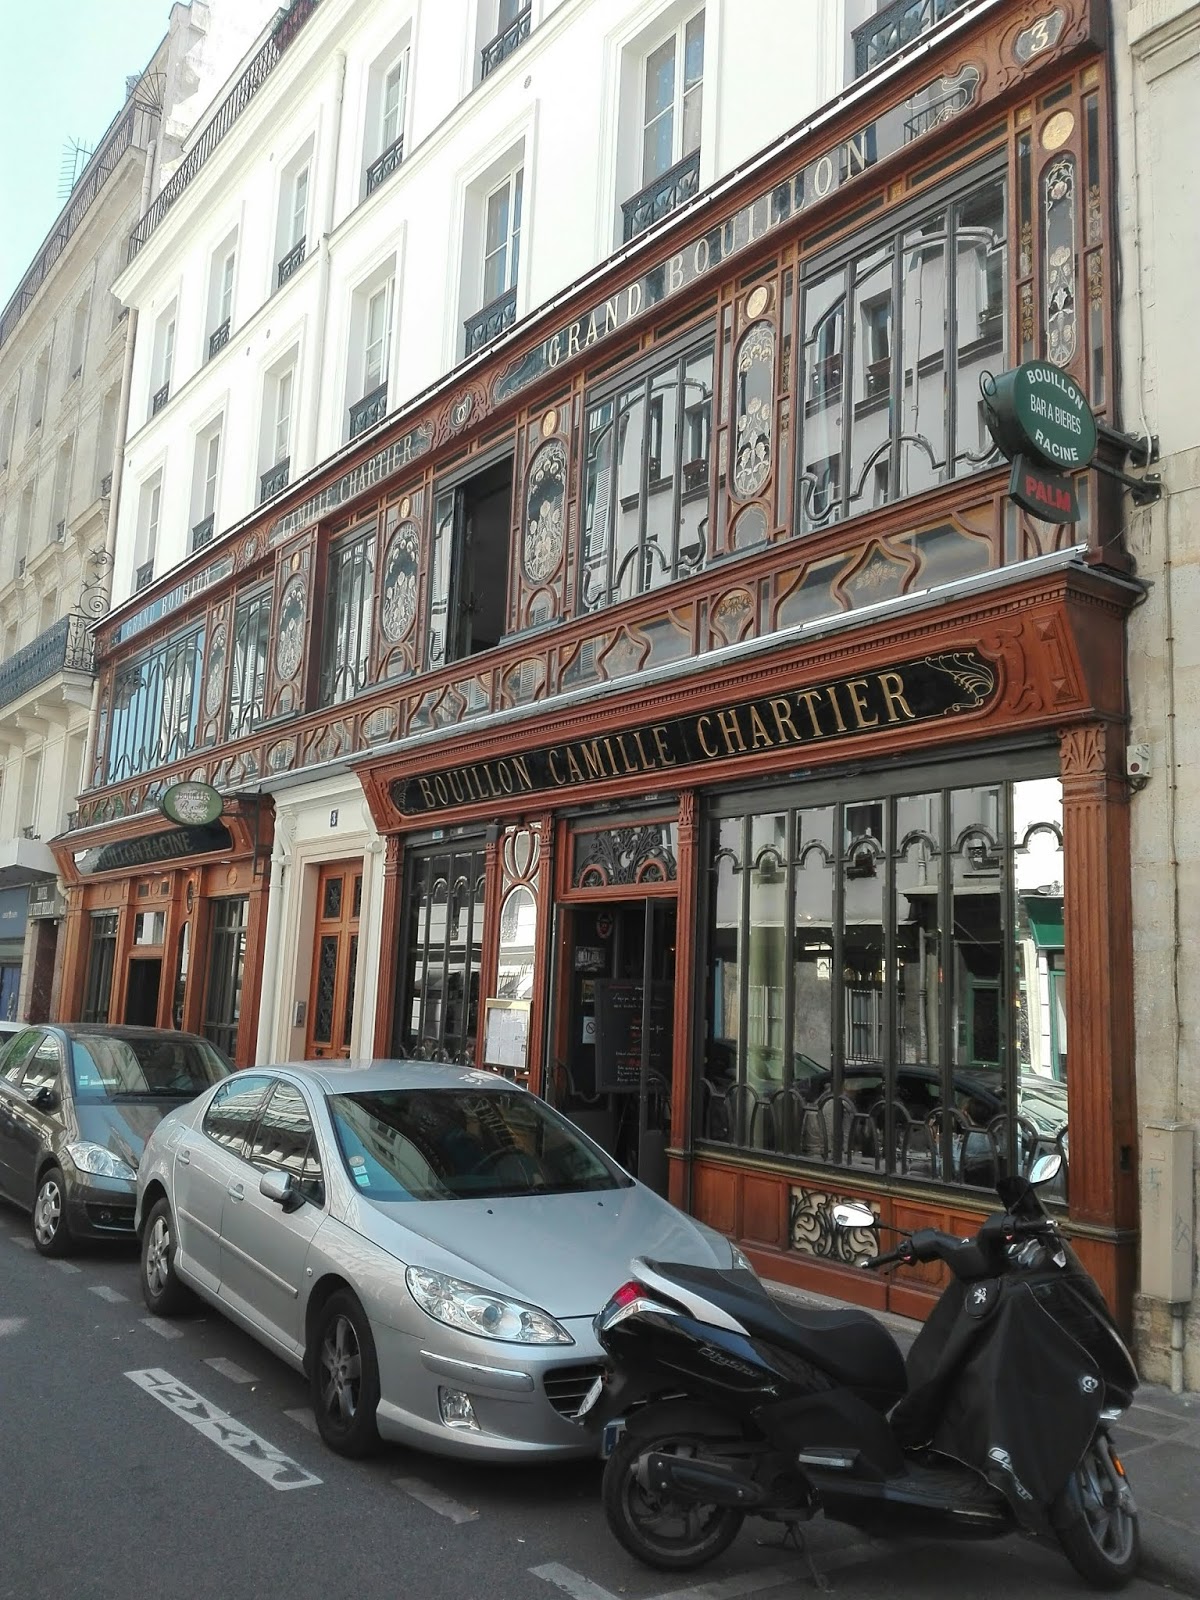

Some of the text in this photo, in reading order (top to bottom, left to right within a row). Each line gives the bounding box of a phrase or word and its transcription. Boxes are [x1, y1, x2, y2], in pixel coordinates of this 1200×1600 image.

[1030, 19, 1049, 51] 3
[548, 129, 868, 368] GRAND BOUILLON
[1026, 368, 1083, 410] BOUILLON
[1030, 393, 1081, 434] BAR A BIERES
[1035, 429, 1078, 461] RACINE
[282, 435, 414, 538] CAMILLE CHARTIER
[1025, 475, 1071, 512] PALM
[418, 671, 917, 809] BOUILLON CAMILLE CHARTIER
[143, 831, 193, 859] RACINE
[144, 1372, 311, 1483] PAYANT
